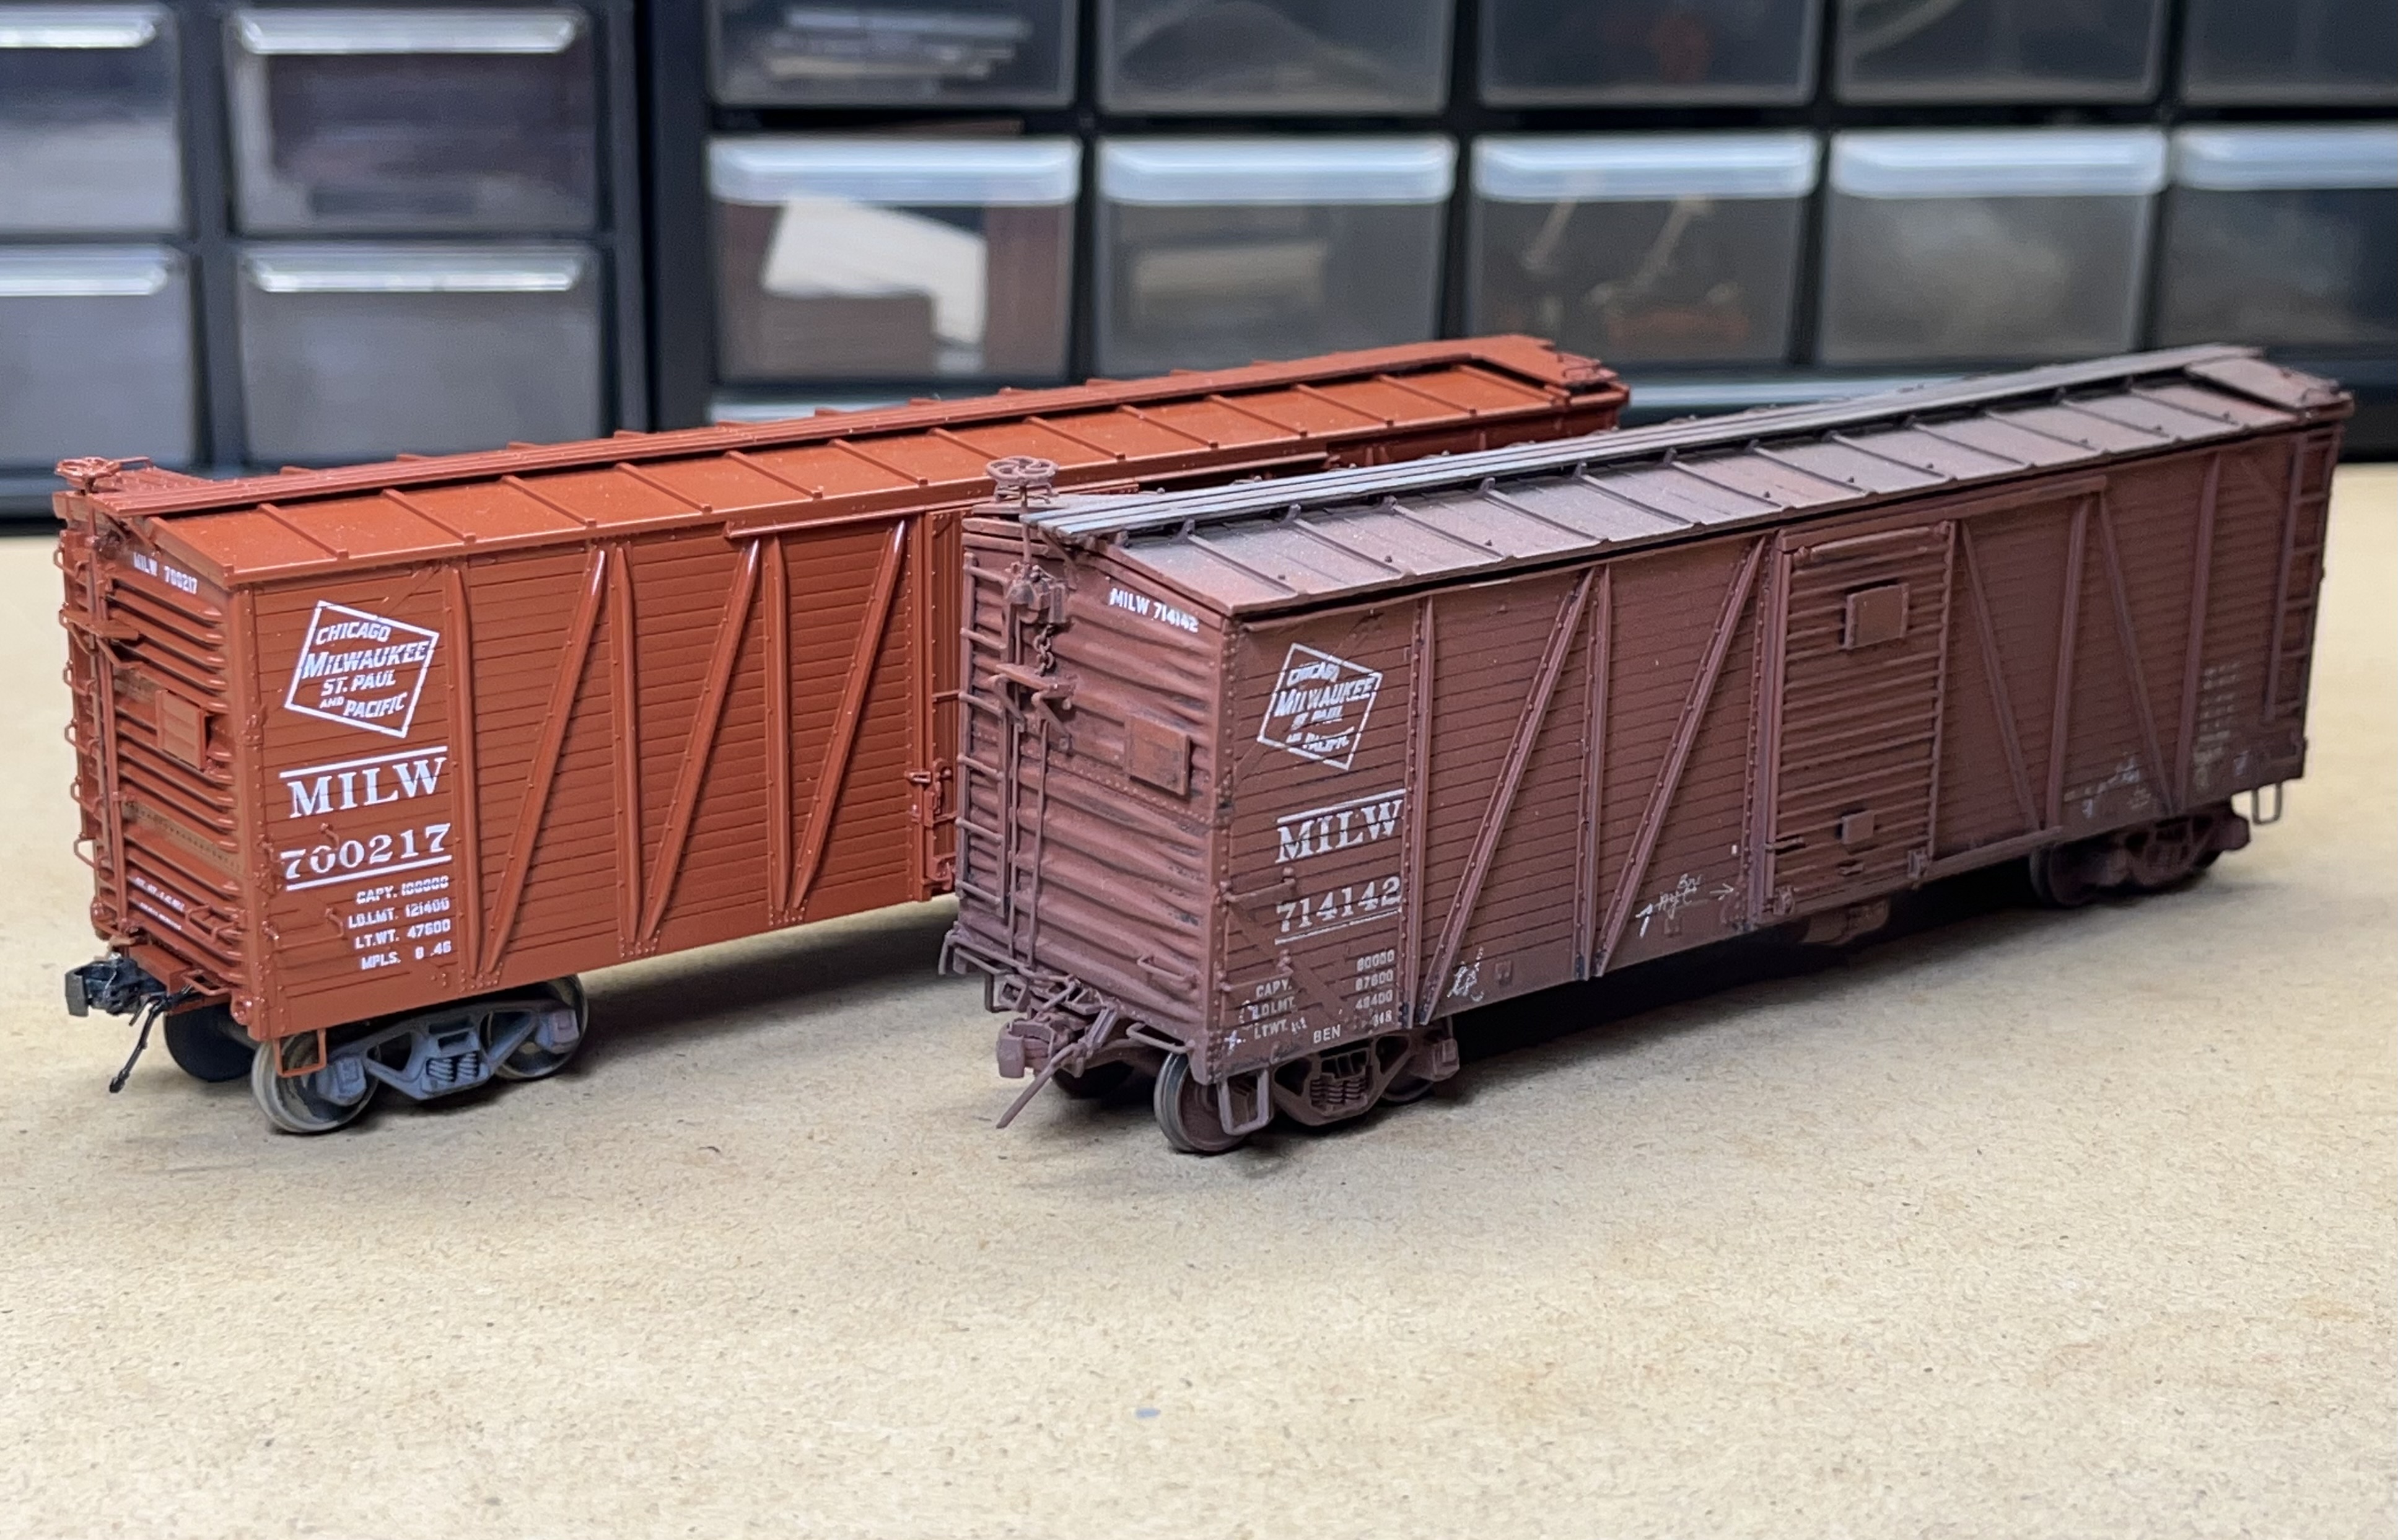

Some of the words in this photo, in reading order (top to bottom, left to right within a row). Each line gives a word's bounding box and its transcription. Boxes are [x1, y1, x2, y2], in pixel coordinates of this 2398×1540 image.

[1109, 587, 1150, 615] MILW
[1152, 602, 1199, 633] 714142
[315, 622, 392, 645] CHICAGO
[321, 676, 348, 696] ST.
[351, 670, 396, 691] PAUL
[319, 696, 345, 708] AND
[343, 692, 408, 718] PACIFIC
[287, 757, 447, 818] MILW
[1275, 800, 1402, 864] MILW
[280, 822, 450, 880] 700217
[356, 885, 397, 904] CAPY.
[405, 897, 450, 917] 121400
[1276, 877, 1402, 932] 714142
[407, 919, 451, 938] 47600
[361, 952, 401, 970] MPLS.
[1313, 1024, 1341, 1044] BEN
